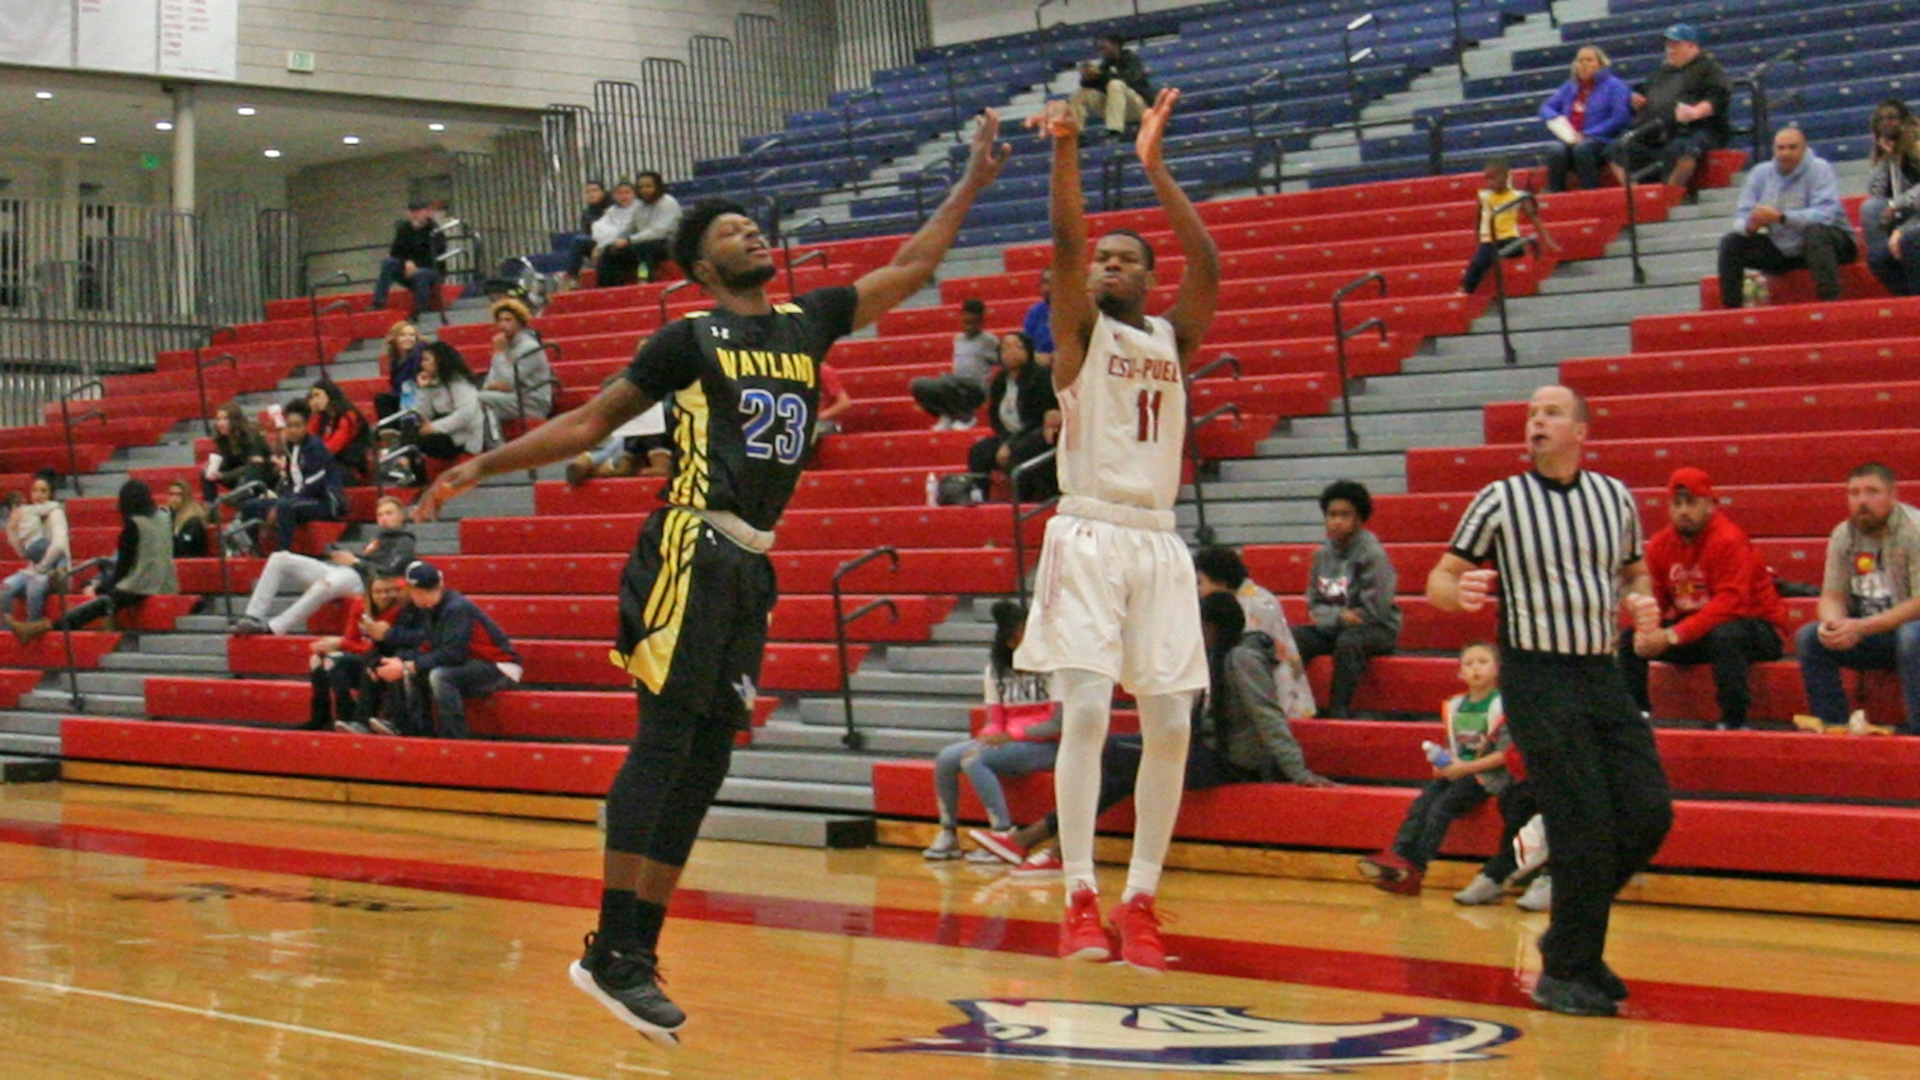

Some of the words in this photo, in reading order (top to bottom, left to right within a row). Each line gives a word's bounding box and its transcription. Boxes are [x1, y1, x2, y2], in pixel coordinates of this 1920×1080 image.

[715, 347, 815, 388] WAYLAND
[738, 388, 808, 464] 23
[1137, 389, 1163, 442] 11
